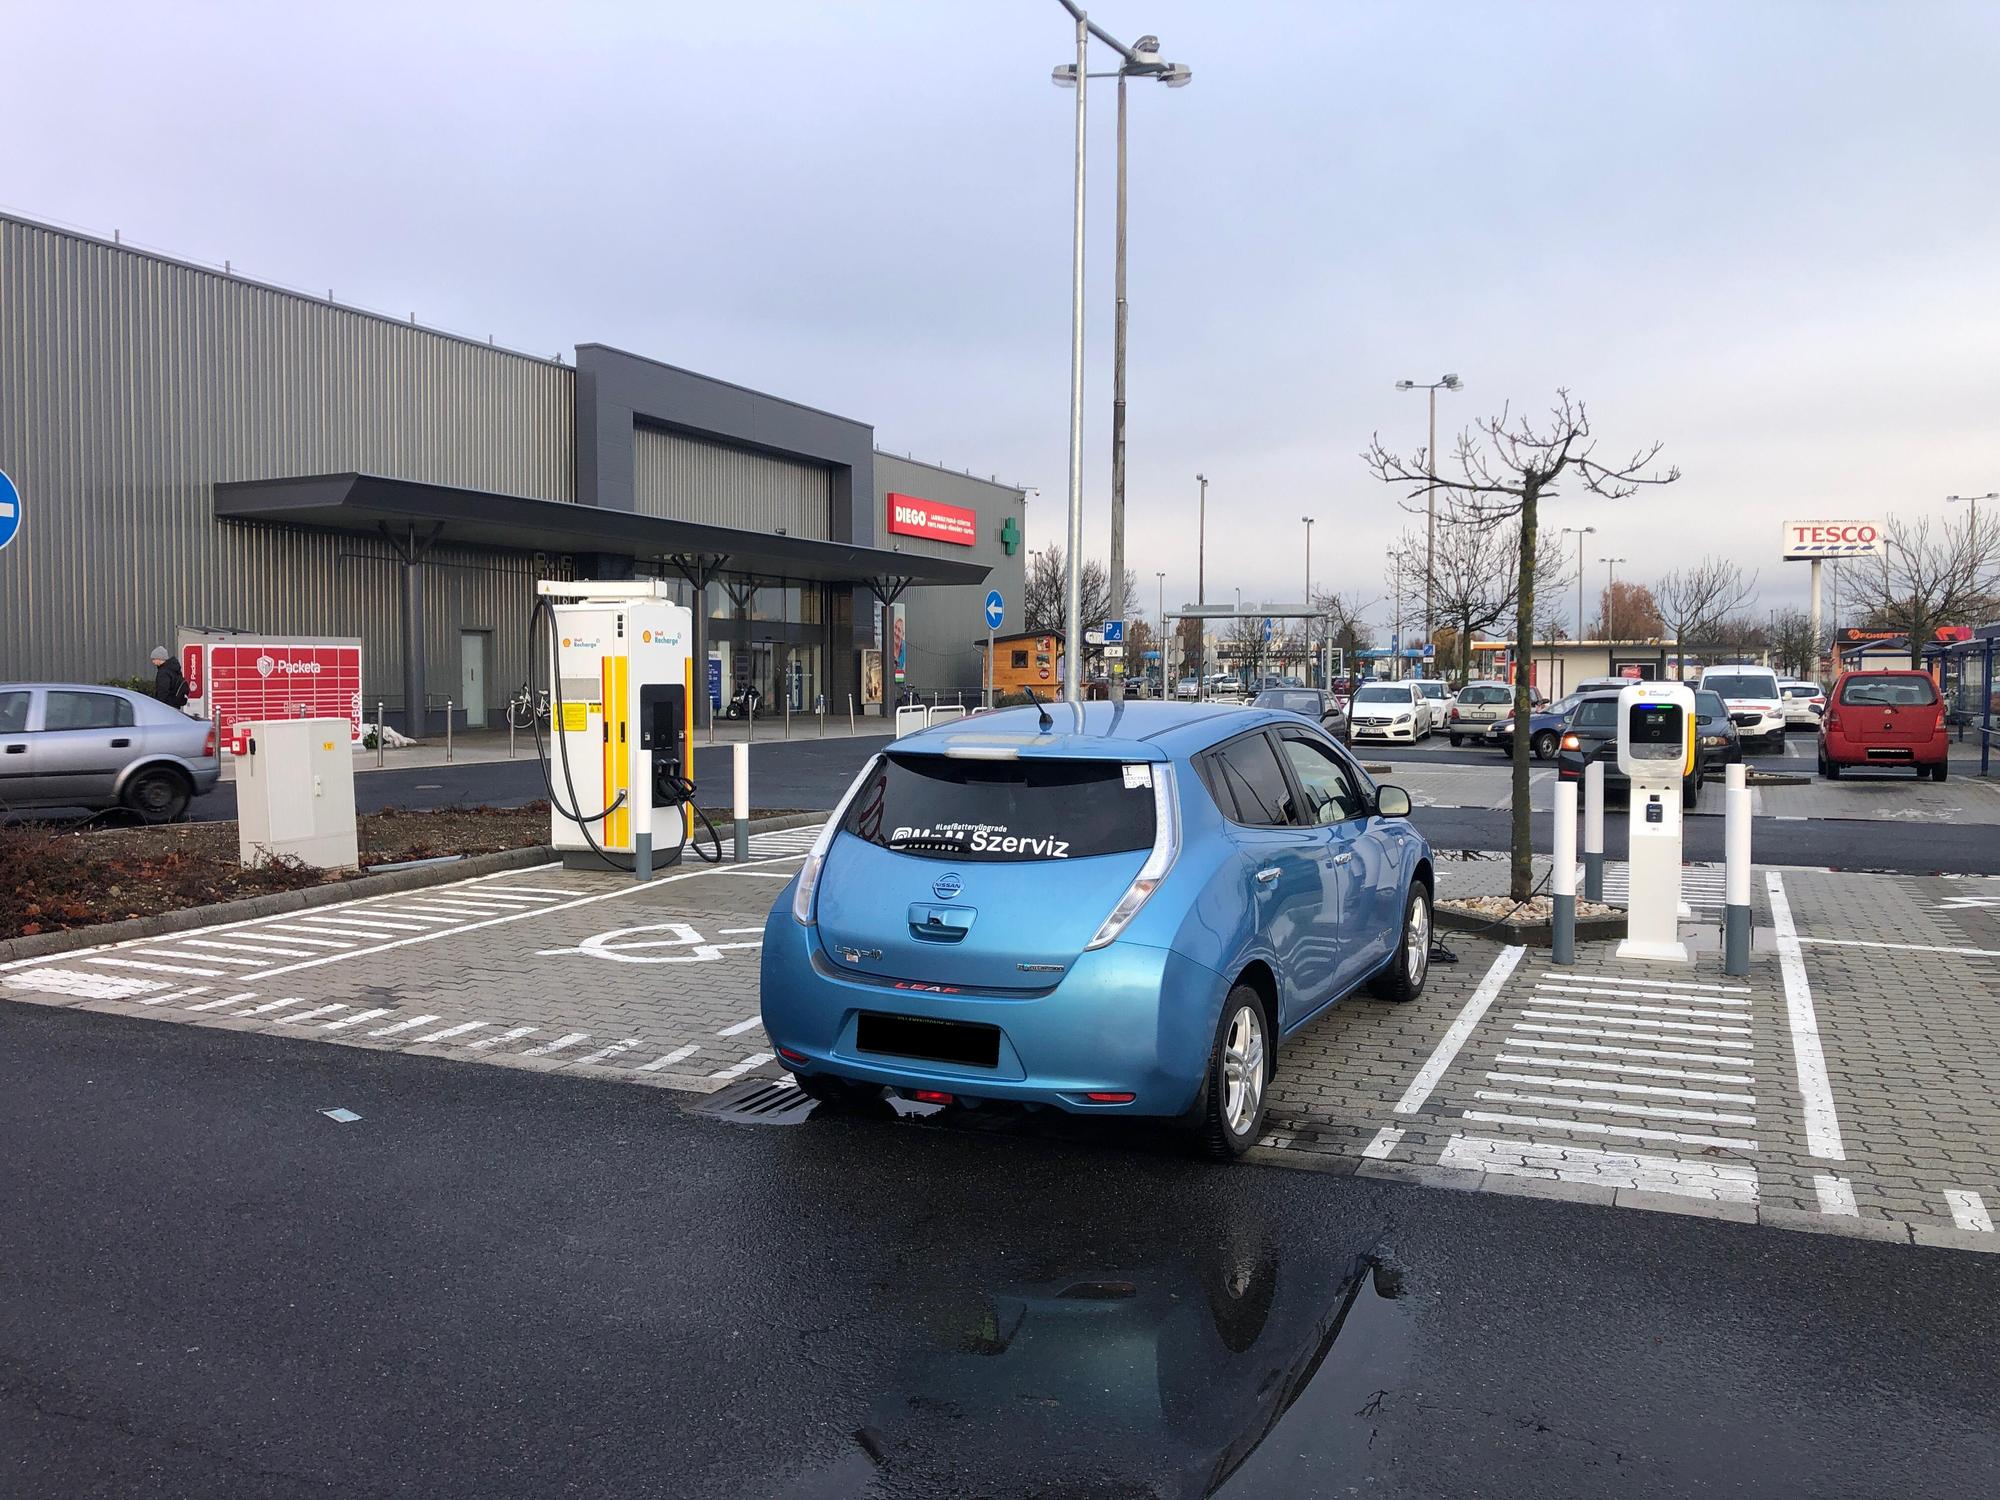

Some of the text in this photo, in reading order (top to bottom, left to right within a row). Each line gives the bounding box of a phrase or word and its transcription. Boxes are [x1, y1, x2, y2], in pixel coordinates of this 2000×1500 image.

[895, 506, 926, 527] DIEGO
[1793, 527, 1876, 543] TESCO
[1106, 623, 1113, 633] P
[655, 637, 678, 646] Recharge
[278, 660, 321, 674] Packeta
[935, 823, 1007, 833] #LeafBatteryUpgrade
[970, 831, 1070, 858] Szerviz
[895, 982, 961, 993] LEAF
